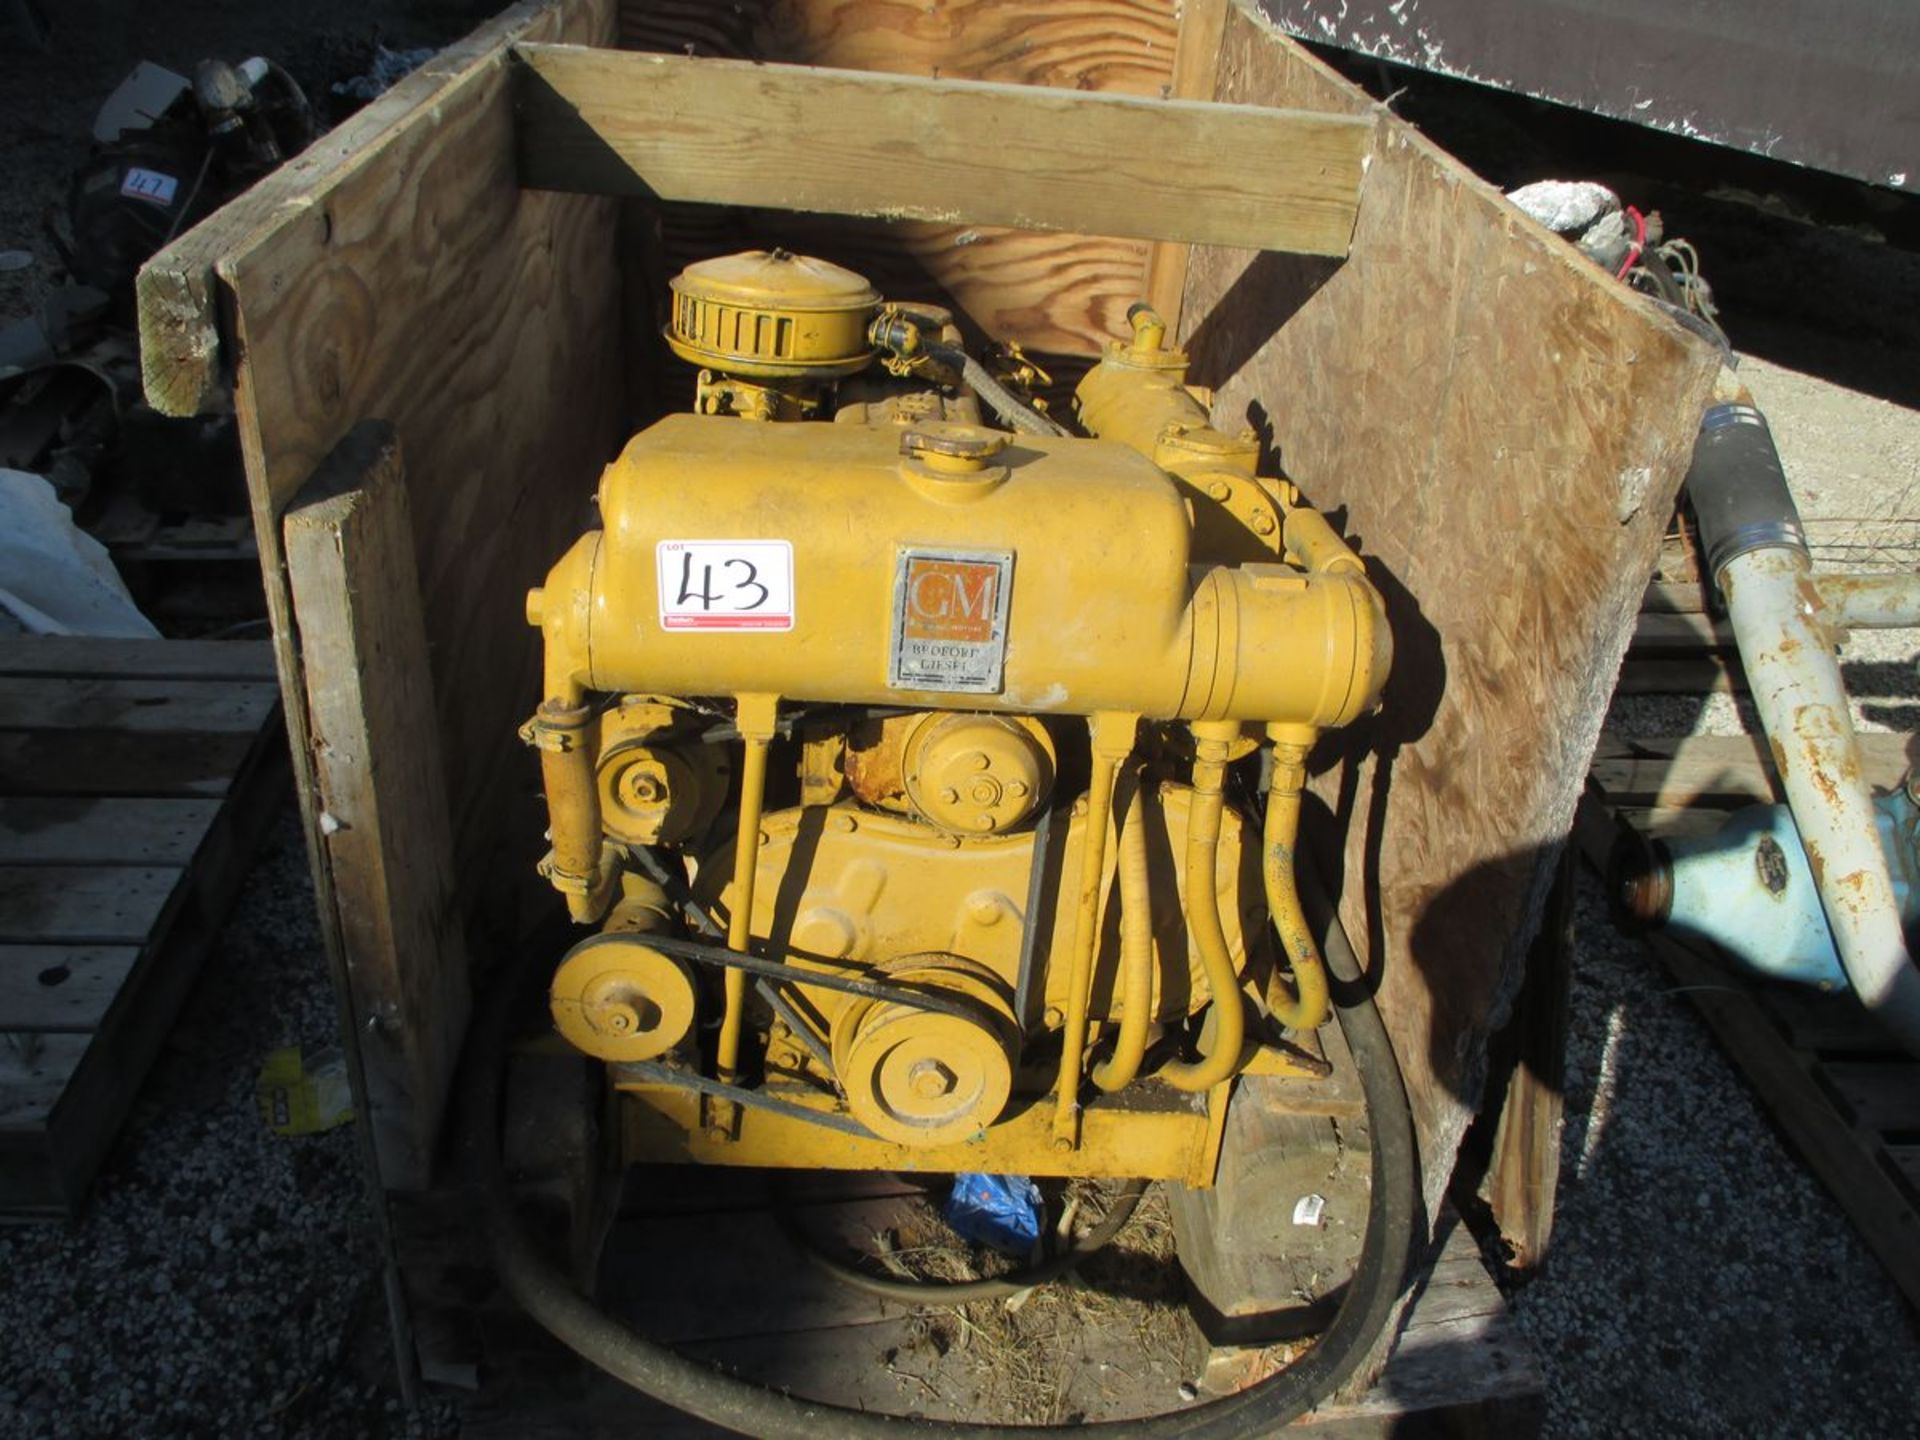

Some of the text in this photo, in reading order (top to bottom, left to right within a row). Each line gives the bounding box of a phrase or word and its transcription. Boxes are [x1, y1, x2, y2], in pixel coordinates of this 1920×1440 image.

[130, 172, 163, 195] 47
[666, 543, 685, 551] LOT
[676, 551, 770, 611] 43
[910, 570, 994, 620] GM
